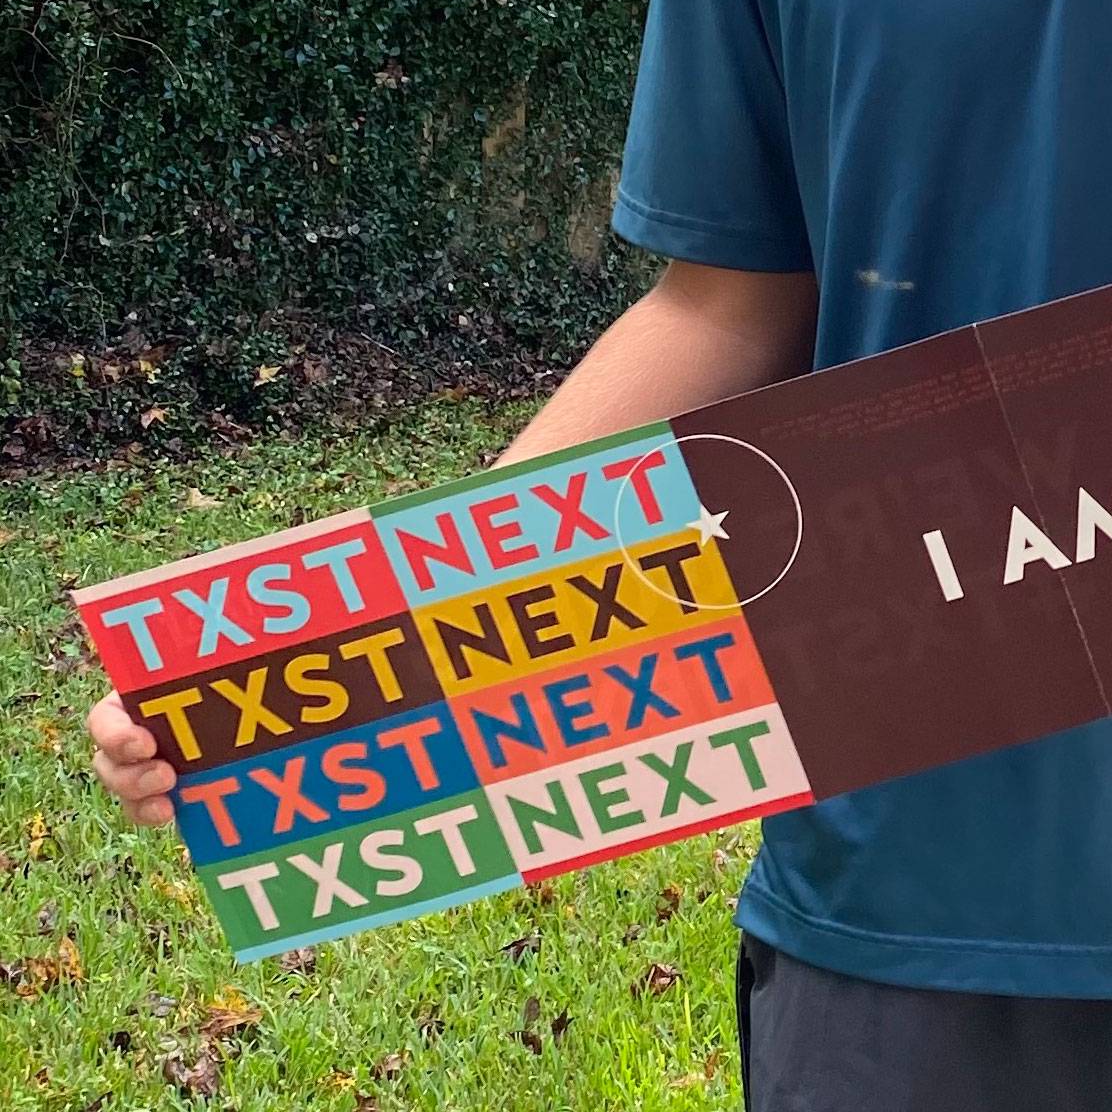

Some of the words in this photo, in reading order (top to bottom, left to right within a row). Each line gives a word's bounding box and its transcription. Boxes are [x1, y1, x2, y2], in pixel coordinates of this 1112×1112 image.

[102, 538, 367, 672] TXST
[395, 450, 668, 589] NEXT
[140, 630, 407, 761] TXST
[428, 541, 701, 681] NEXT
[922, 529, 964, 602] I
[180, 719, 444, 848] TXST
[470, 632, 737, 768] NEXT
[218, 807, 482, 931] TXST
[504, 720, 773, 856] NEXT
